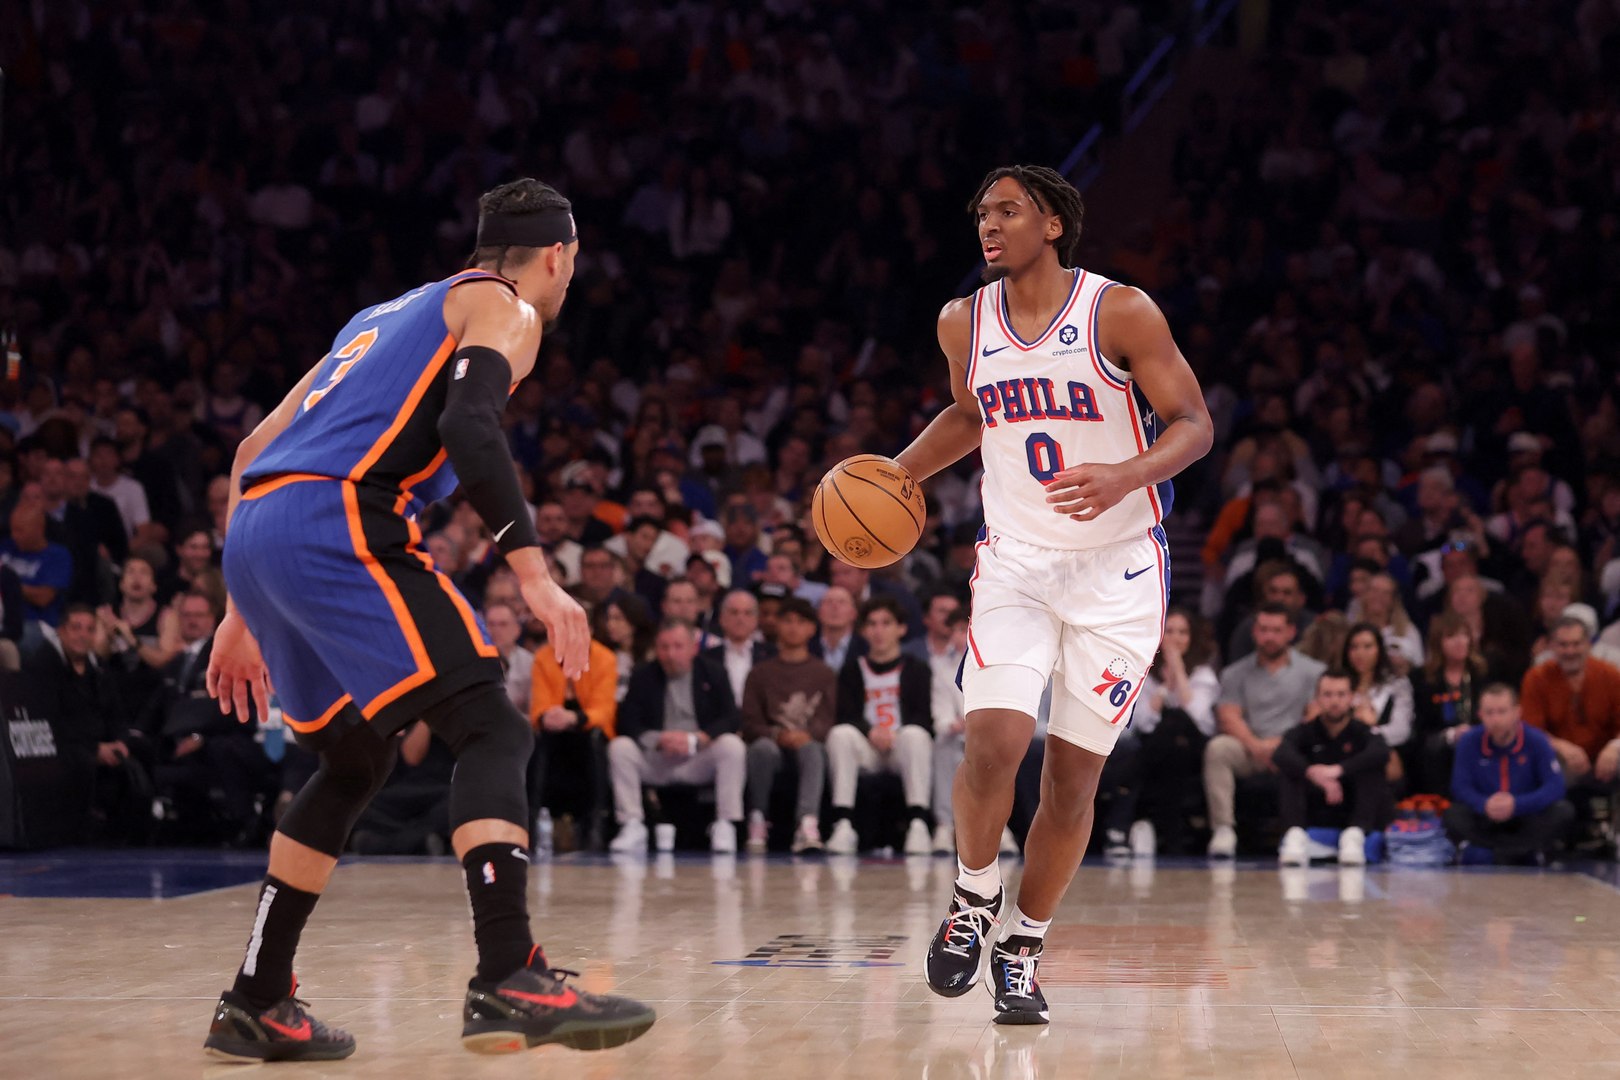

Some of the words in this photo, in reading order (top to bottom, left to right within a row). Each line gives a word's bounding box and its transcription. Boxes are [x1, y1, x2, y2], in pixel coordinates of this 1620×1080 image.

[1052, 346, 1088, 357] crypto.com
[976, 378, 1104, 428] PHILA
[1025, 432, 1065, 486] 0
[1092, 667, 1132, 707] 76
[876, 703, 894, 728] 5
